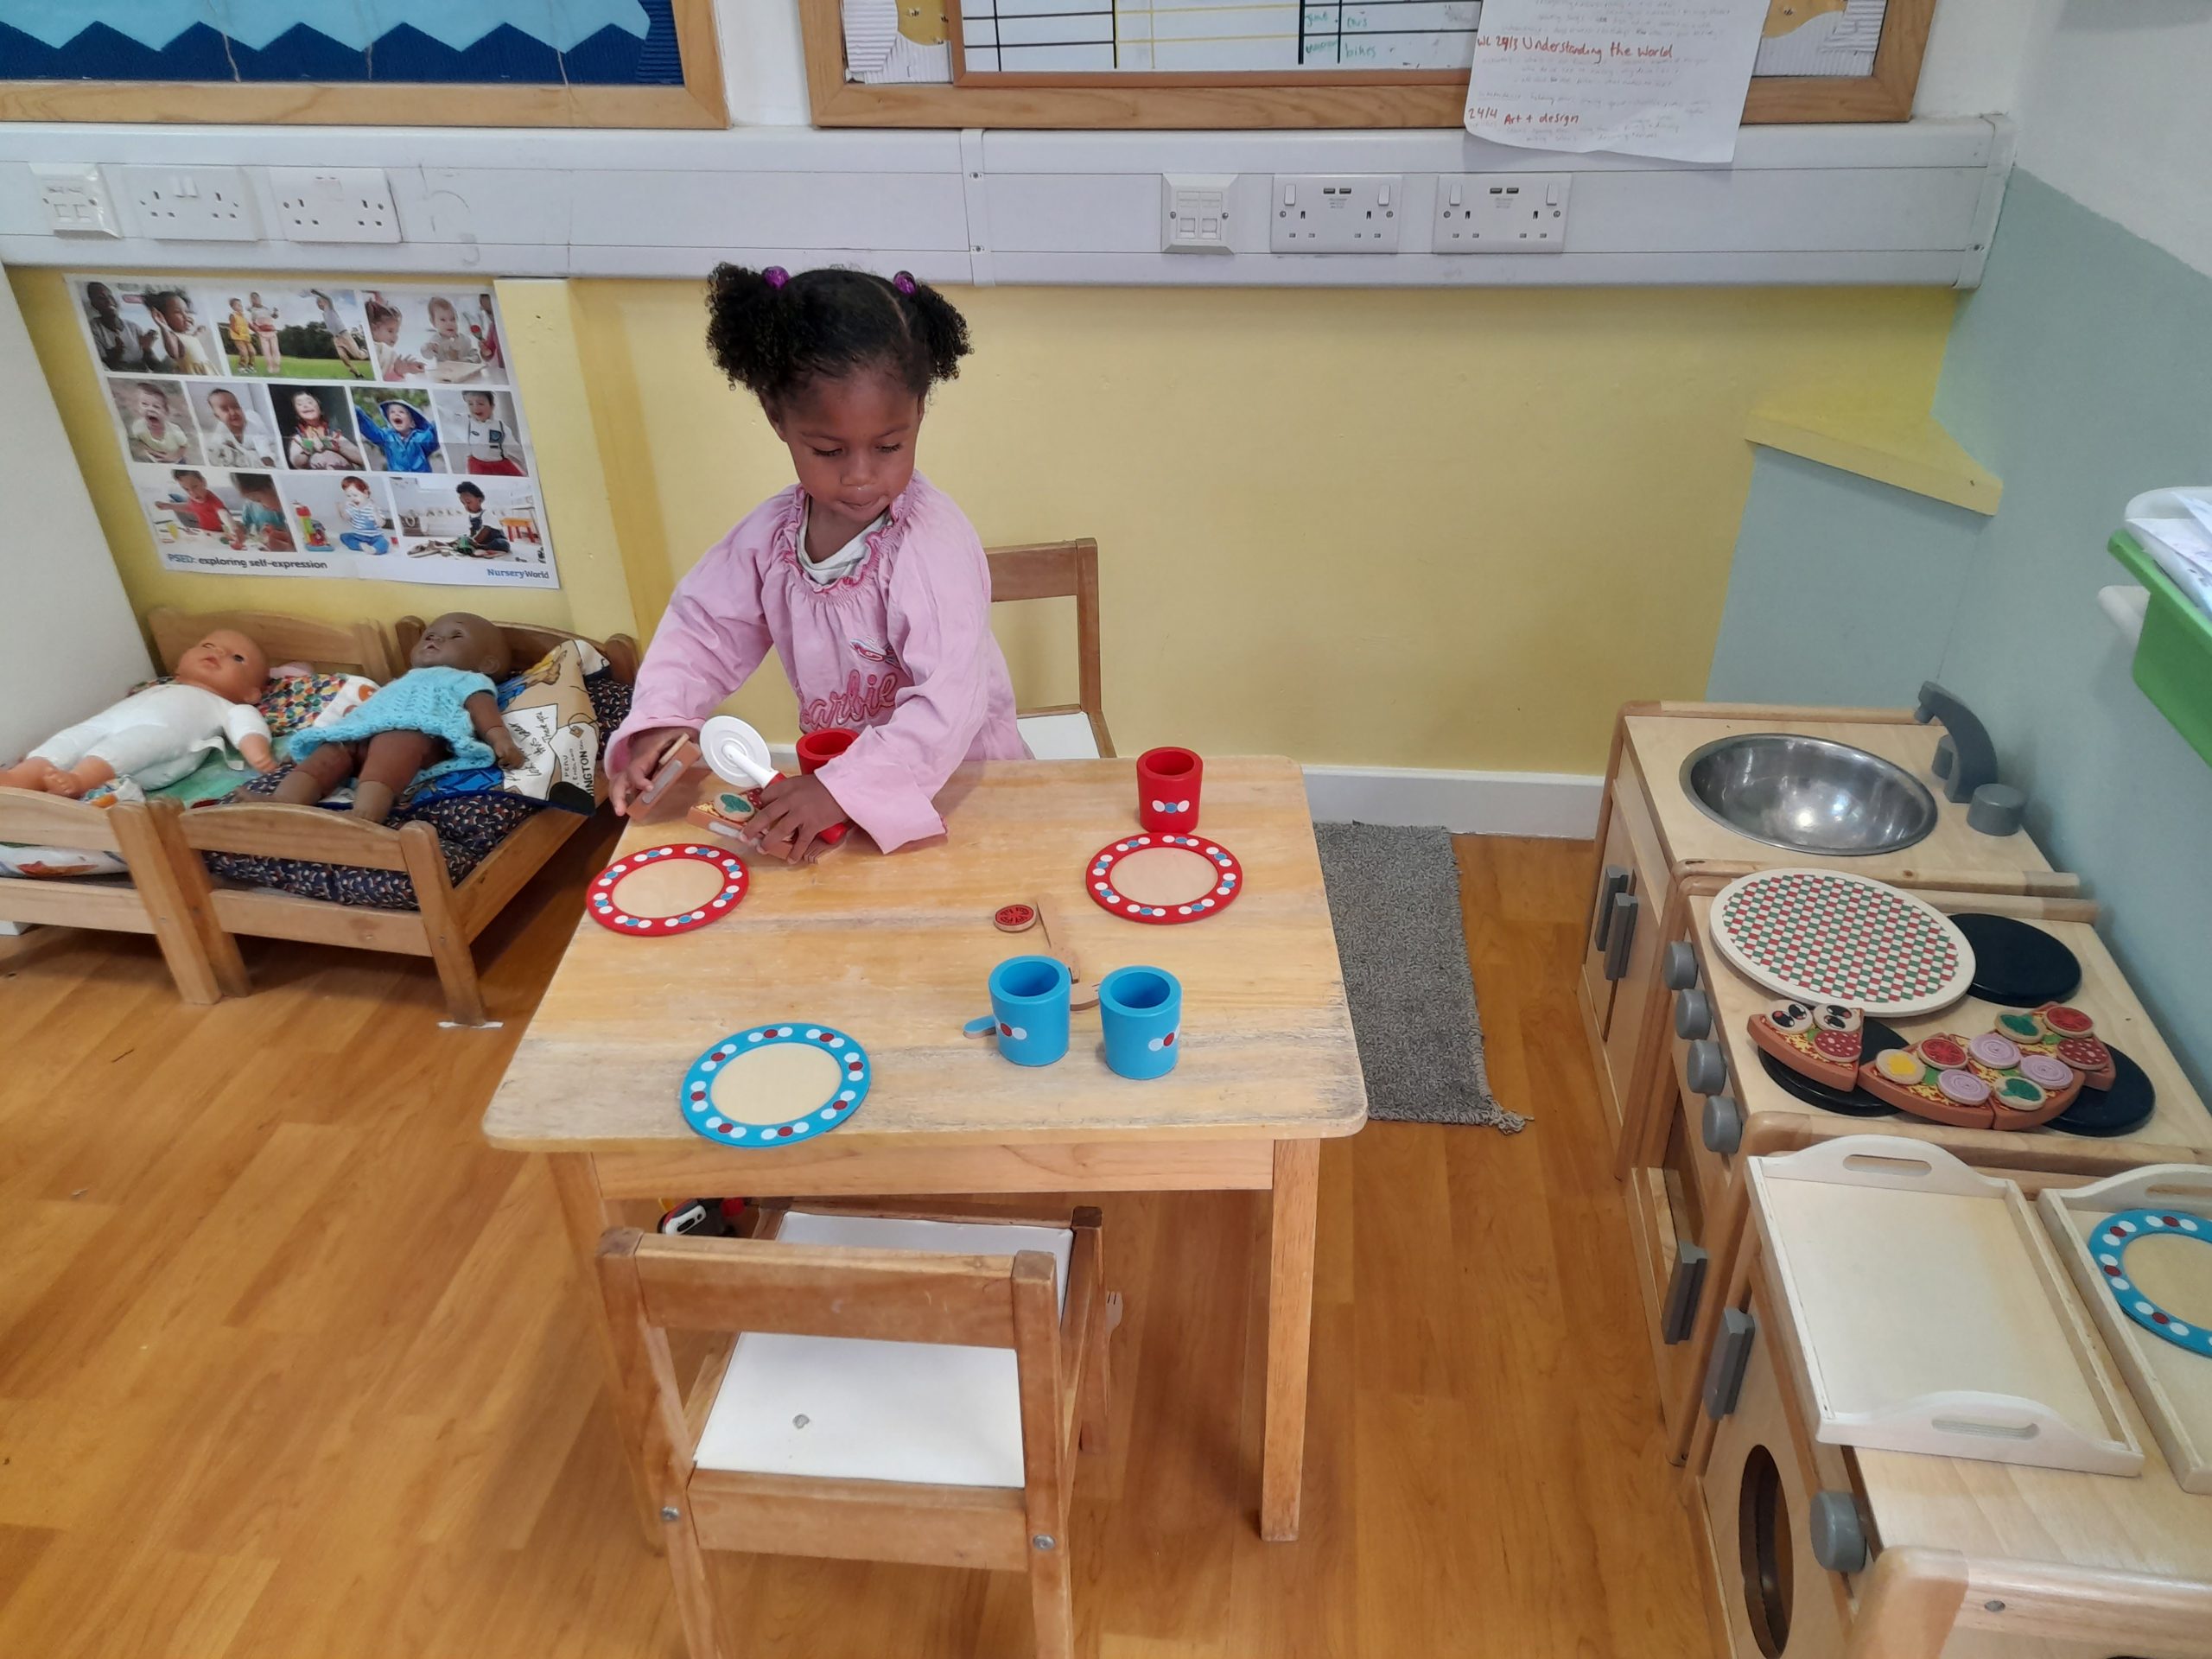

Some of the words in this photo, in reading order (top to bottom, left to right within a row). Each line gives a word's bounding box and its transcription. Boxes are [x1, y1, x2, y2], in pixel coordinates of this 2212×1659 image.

[1522, 37, 1603, 64] Understanding
[1610, 41, 1631, 57] the
[1468, 107, 1497, 119] 24/4
[1504, 113, 1522, 125] Art
[1540, 113, 1579, 127] design
[198, 556, 247, 569] exploring
[249, 558, 328, 570] self-expression
